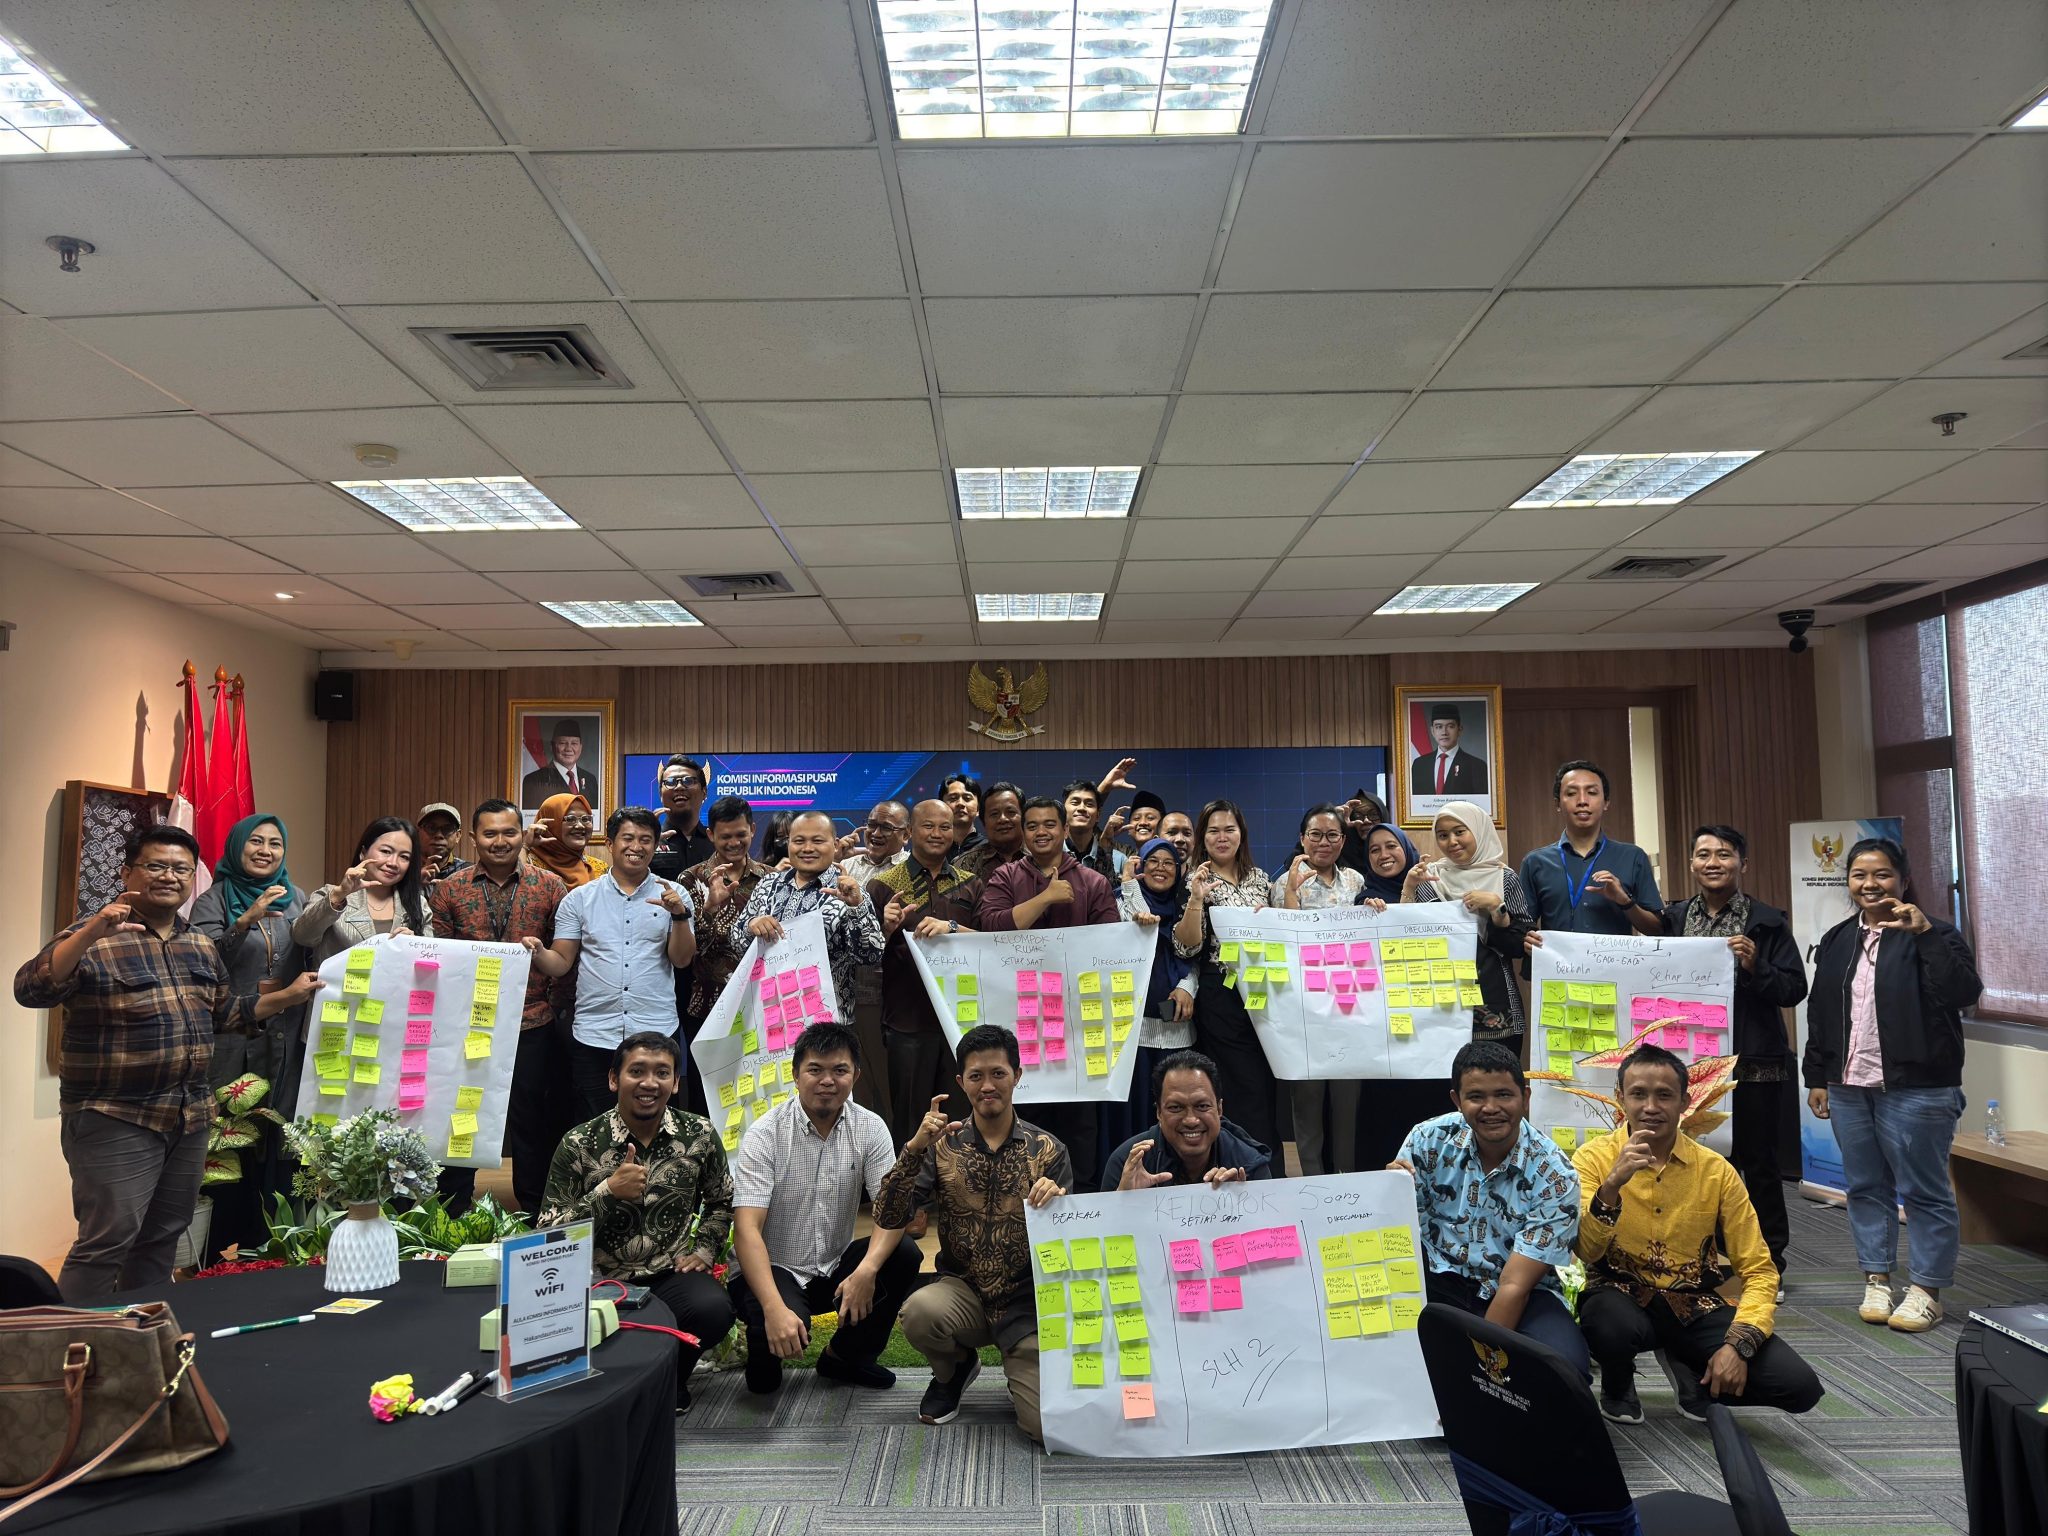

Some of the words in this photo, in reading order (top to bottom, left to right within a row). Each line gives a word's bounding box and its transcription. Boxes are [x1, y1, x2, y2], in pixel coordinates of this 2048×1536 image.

[717, 774, 751, 783] KOMISI
[752, 773, 806, 783] INFORMASI
[806, 773, 838, 783] PUSAT
[717, 786, 763, 796] REPUBLIK
[764, 785, 817, 795] INDONESIA
[1277, 912, 1310, 922] KELOMPOK
[1312, 912, 1320, 922] 3
[1328, 910, 1380, 922] NUSANTARA
[993, 932, 1051, 947] KELOMPOK
[1056, 931, 1065, 944] 4
[1228, 927, 1263, 939] BERKALA
[1315, 932, 1337, 941] SETIAP
[1338, 931, 1358, 940] SAAT
[408, 941, 439, 951] SETIAP
[420, 950, 443, 960] SAAT
[765, 953, 790, 966] SETIAP
[793, 943, 813, 957] SAAT
[1026, 957, 1045, 968] SAAT
[742, 1048, 796, 1070] DIKECUALIK
[1154, 1190, 1279, 1222] KELOMPOK
[1052, 1211, 1102, 1225] BERKALA
[1180, 1214, 1218, 1228] SETIAP
[1219, 1213, 1244, 1224] SAAT
[521, 1243, 580, 1262] WELCOME
[513, 1316, 526, 1324] AULA
[526, 1312, 542, 1320] KOMISI
[542, 1306, 569, 1317] INFORMASI
[568, 1302, 583, 1310] PUSAT
